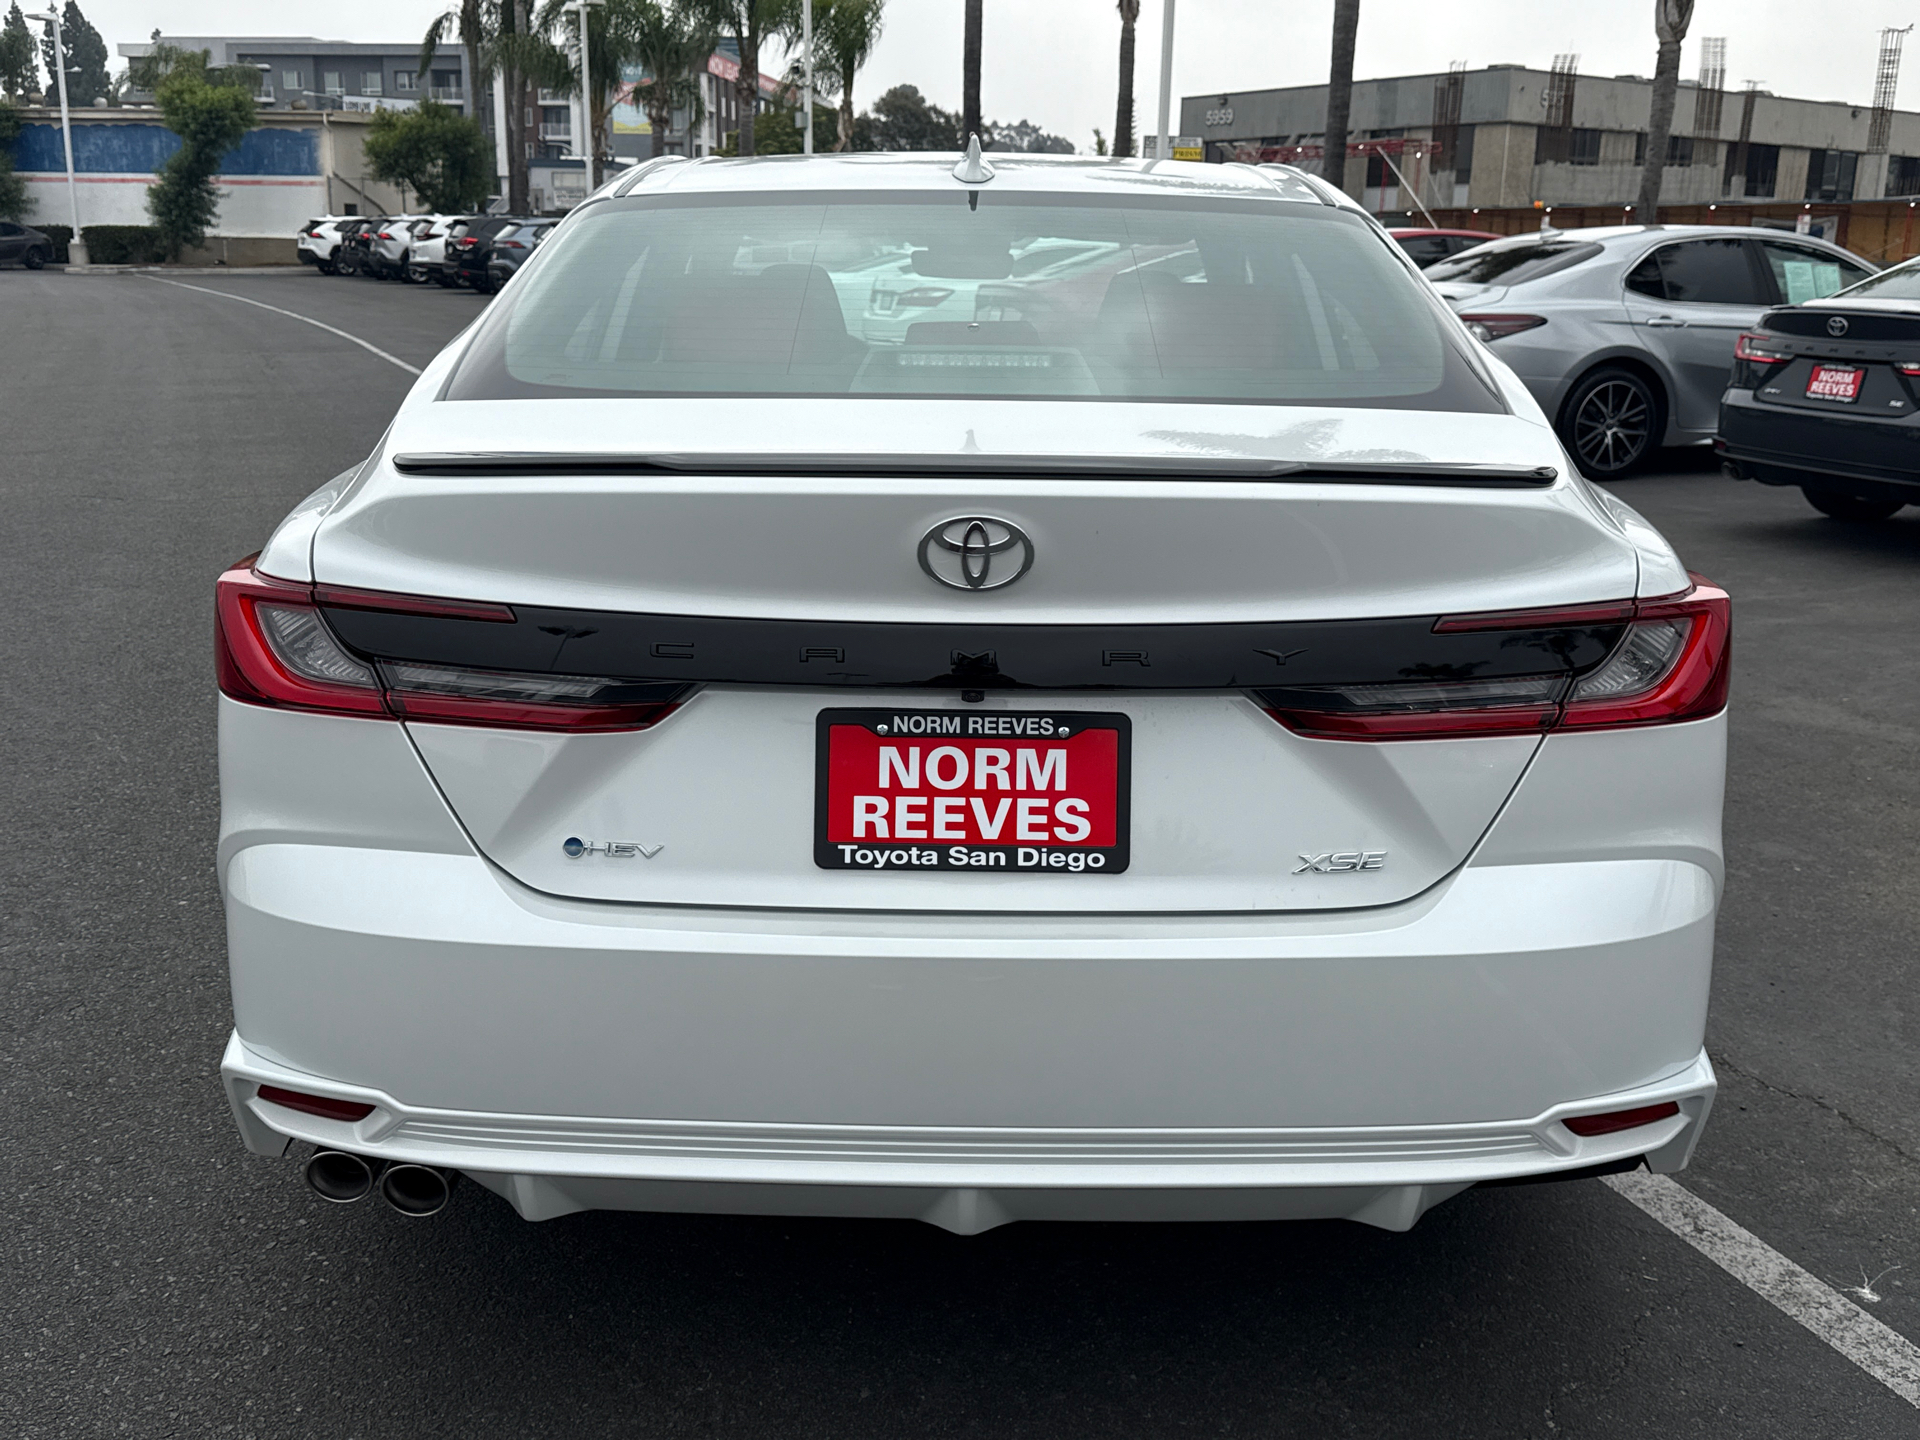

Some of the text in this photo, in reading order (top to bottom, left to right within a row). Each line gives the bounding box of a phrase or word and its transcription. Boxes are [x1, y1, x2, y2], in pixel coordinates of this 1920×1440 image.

[1205, 108, 1233, 126] 5959
[1811, 381, 1855, 396] REEVES
[1818, 370, 1855, 384] NORM
[649, 641, 1309, 668] CAMRY
[892, 715, 1055, 736] NORM REEVES
[878, 745, 1067, 792] NORM
[852, 795, 1092, 842] REEVES
[586, 840, 665, 860] HEV
[837, 844, 1106, 872] Toyota San Diego
[1291, 850, 1389, 875] XSE
